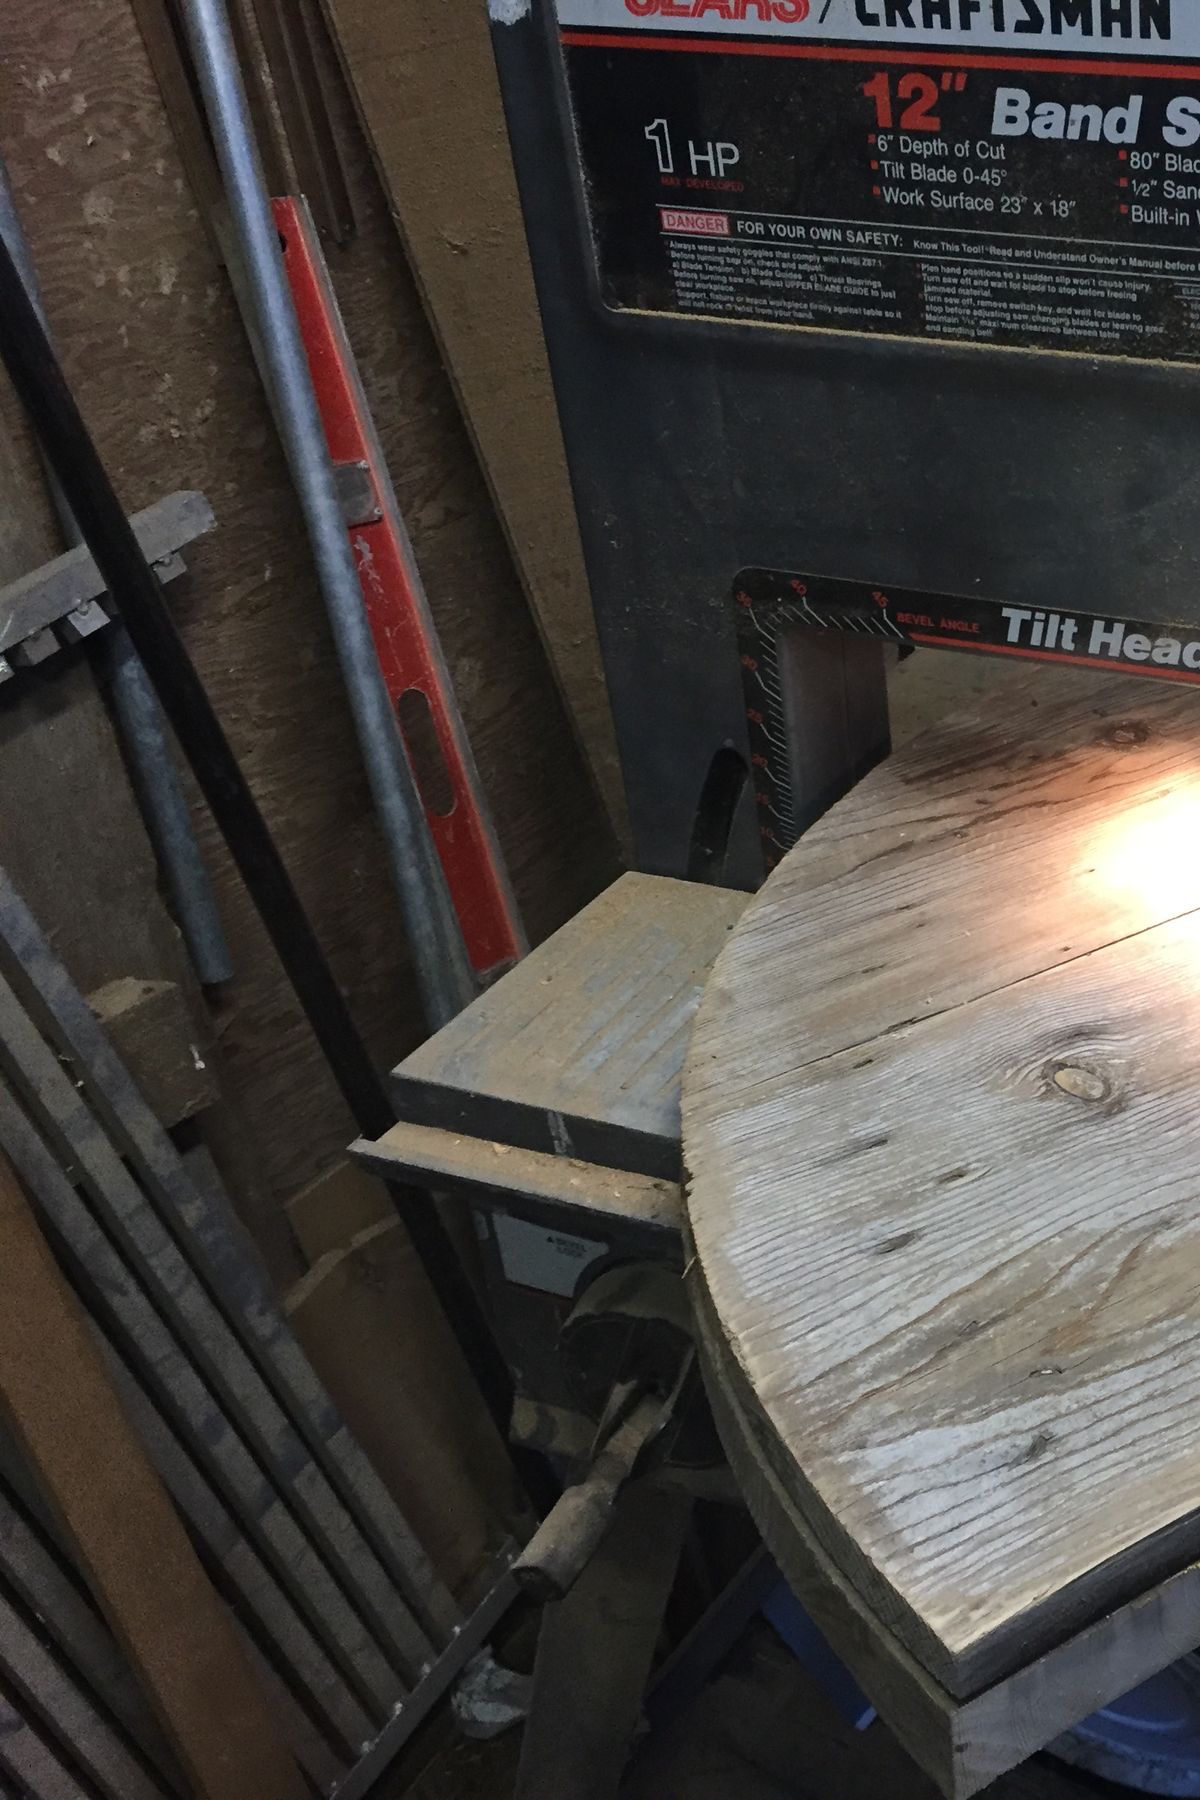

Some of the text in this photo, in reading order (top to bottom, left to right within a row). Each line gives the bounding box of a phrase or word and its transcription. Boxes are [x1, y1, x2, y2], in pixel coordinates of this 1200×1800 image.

[991, 86, 1143, 145] Band
[644, 118, 740, 177] 1 HP
[899, 136, 949, 159] Depth
[954, 140, 970, 157] of
[976, 141, 1006, 160] Cut
[880, 160, 905, 180] Tilt
[910, 163, 957, 183] Blade
[883, 186, 925, 205] Work
[930, 190, 994, 212] Surface
[1033, 202, 1043, 215] x
[1131, 204, 1190, 226] Built-in
[666, 213, 725, 232] DANGER
[736, 220, 764, 235] FOR
[767, 223, 806, 239] YOUR
[809, 227, 842, 242] OWN
[846, 230, 902, 248] SAFETY:
[912, 239, 938, 250] Know
[940, 242, 960, 252] This
[989, 246, 1012, 257] Read
[1014, 249, 1031, 258] and
[1033, 250, 1086, 263] Understand
[1088, 256, 1126, 267] Owner's
[1128, 257, 1162, 268] Manual
[1163, 260, 1195, 271] before
[669, 240, 696, 251] Always
[717, 245, 741, 256] safety
[774, 250, 790, 259] that
[791, 251, 820, 263] comply
[704, 263, 734, 273] Tension
[751, 268, 772, 277] Blade
[846, 276, 881, 288] Bearings
[922, 273, 940, 281] Turn
[960, 276, 971, 284] off
[972, 277, 988, 286] and
[1058, 285, 1076, 296] stop
[1078, 287, 1104, 297] before
[1106, 290, 1136, 301] freeing
[940, 265, 961, 274] hand
[962, 267, 1002, 279] positions
[1022, 272, 1053, 282] sudden
[1055, 276, 1070, 286] slip
[1098, 281, 1123, 289] cause
[784, 280, 812, 290] UPPER
[842, 286, 868, 295] GUIDE
[880, 289, 896, 299] just
[924, 283, 956, 295] jammed
[923, 293, 942, 302] Turn
[976, 299, 1007, 308] remove
[1008, 301, 1036, 310] switch
[1055, 306, 1072, 314] and
[1073, 307, 1091, 316] wait
[1093, 309, 1104, 317] for
[925, 304, 943, 314] stop
[944, 305, 970, 315] before
[972, 308, 1010, 320] adjusting
[1031, 313, 1070, 325] changing
[1071, 317, 1099, 327] blades
[1111, 321, 1143, 332] leaving
[897, 611, 980, 635] BEVEL ANGLE
[1001, 606, 1079, 652] Tilt
